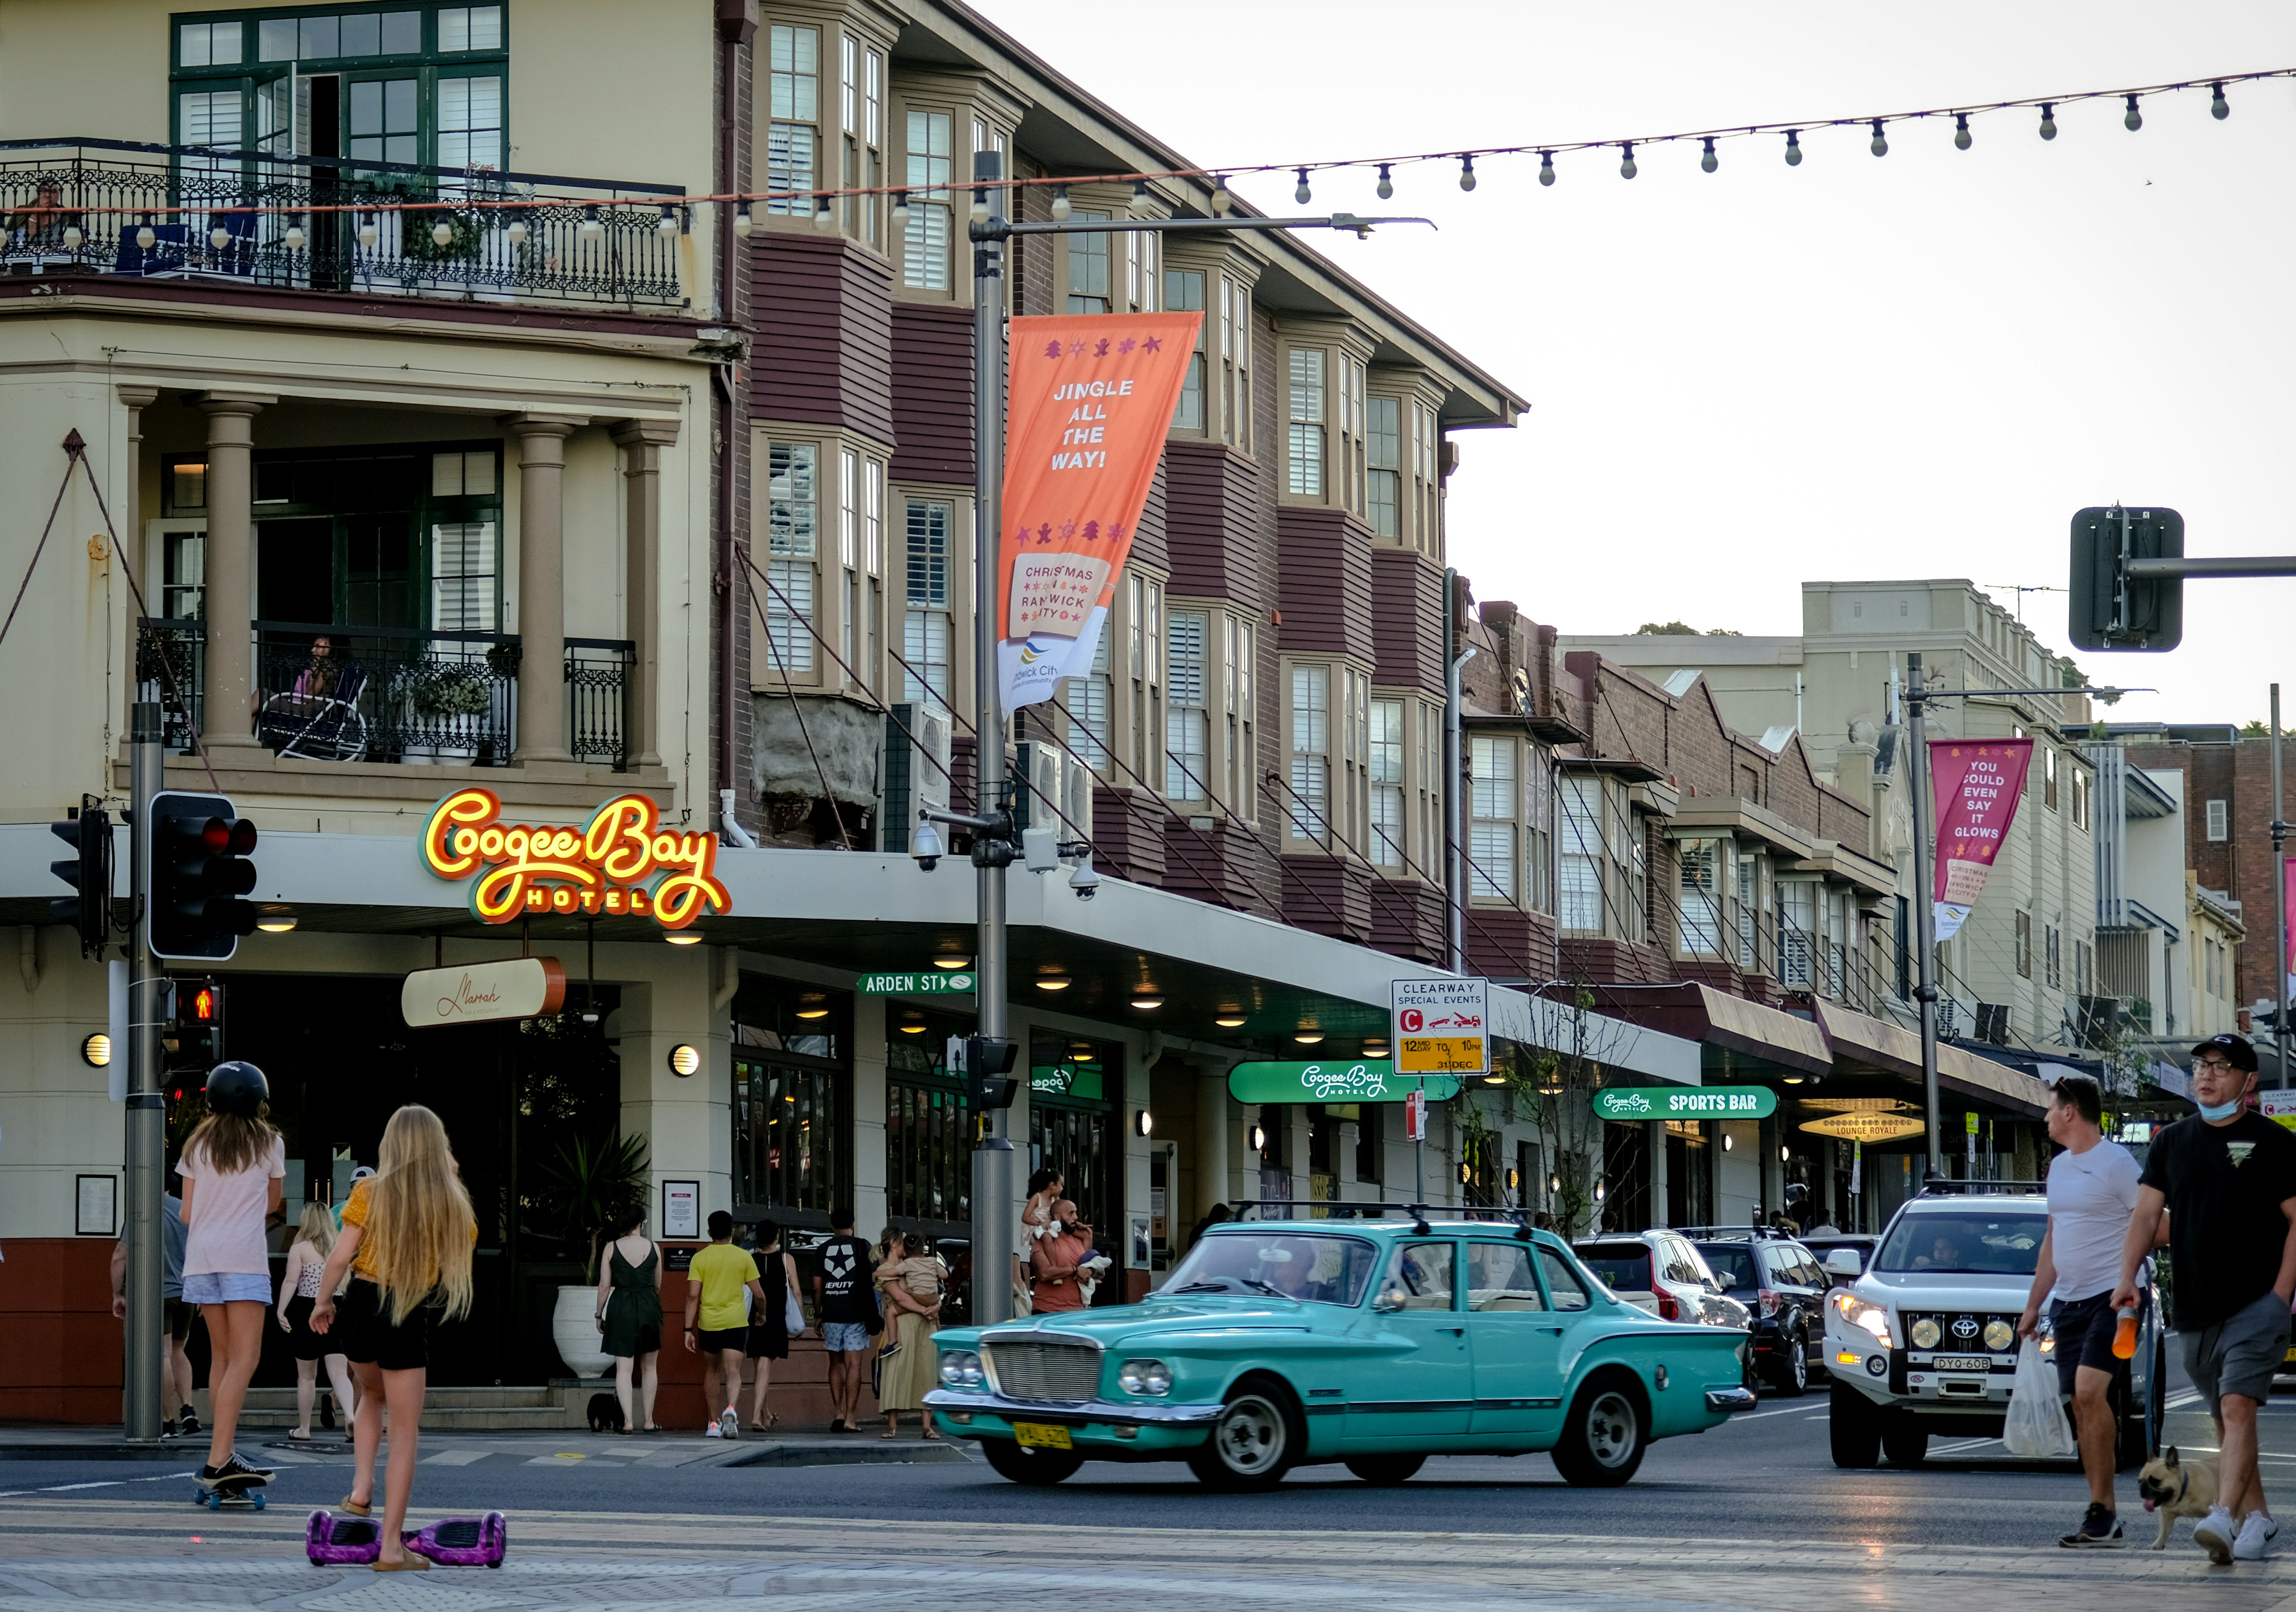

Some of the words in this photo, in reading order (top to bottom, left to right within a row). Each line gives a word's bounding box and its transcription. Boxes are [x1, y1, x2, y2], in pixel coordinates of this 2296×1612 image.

[1053, 380, 1133, 401] JINGLE
[1068, 404, 1106, 424] ALL
[1063, 427, 1105, 445] THE
[1052, 451, 1106, 470] WAY!
[1970, 761, 1997, 773] YOU
[1964, 787, 1997, 799] EVEN
[1967, 800, 1992, 811] SAY
[1972, 813, 1984, 824] IT
[1954, 827, 1999, 839] GLOWS
[426, 792, 595, 917] Coogee
[584, 798, 723, 923] Bay
[527, 889, 644, 909] HOTEL
[866, 975, 914, 992] ARDEN
[921, 975, 937, 991] ST
[1403, 983, 1474, 994] CLEARWAY
[437, 972, 500, 1017] Marrah
[1444, 996, 1481, 1004] EVENTS
[1405, 1011, 1419, 1031] C
[1404, 1041, 1417, 1052] 12
[1436, 1043, 1448, 1052] TO
[1301, 1065, 1350, 1098] Coogee
[1346, 1065, 1388, 1098] Bay
[1603, 1093, 1631, 1113] Coogee
[1629, 1093, 1652, 1113] Bay
[1669, 1094, 1726, 1111] SPORTS
[1729, 1094, 1757, 1110] BAR
[1837, 1127, 1866, 1135] LOUNGE
